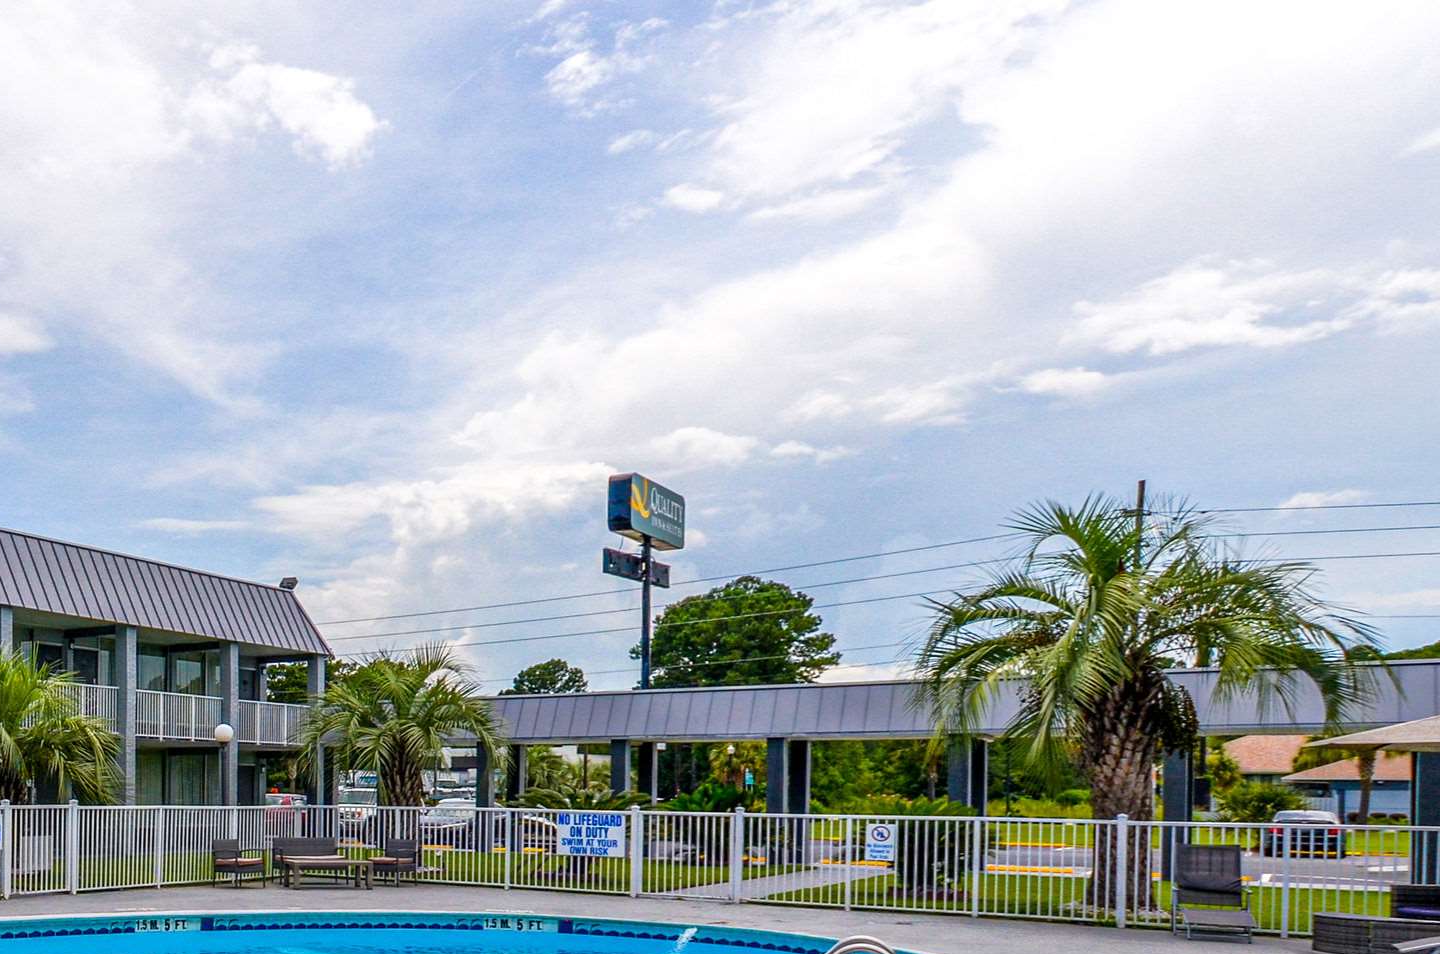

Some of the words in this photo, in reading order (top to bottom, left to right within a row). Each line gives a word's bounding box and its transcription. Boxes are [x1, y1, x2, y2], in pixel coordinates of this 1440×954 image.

[558, 812, 570, 825] NO
[574, 813, 622, 827] LIFEGUARD
[570, 826, 582, 838] ON
[586, 827, 608, 839] DUTY
[561, 838, 583, 846] SWIM
[586, 838, 595, 847] AT
[597, 839, 618, 848] YOUR
[570, 846, 587, 855] OWN
[590, 847, 608, 856] RISK
[165, 919, 171, 931] 5
[517, 919, 523, 931] 5
